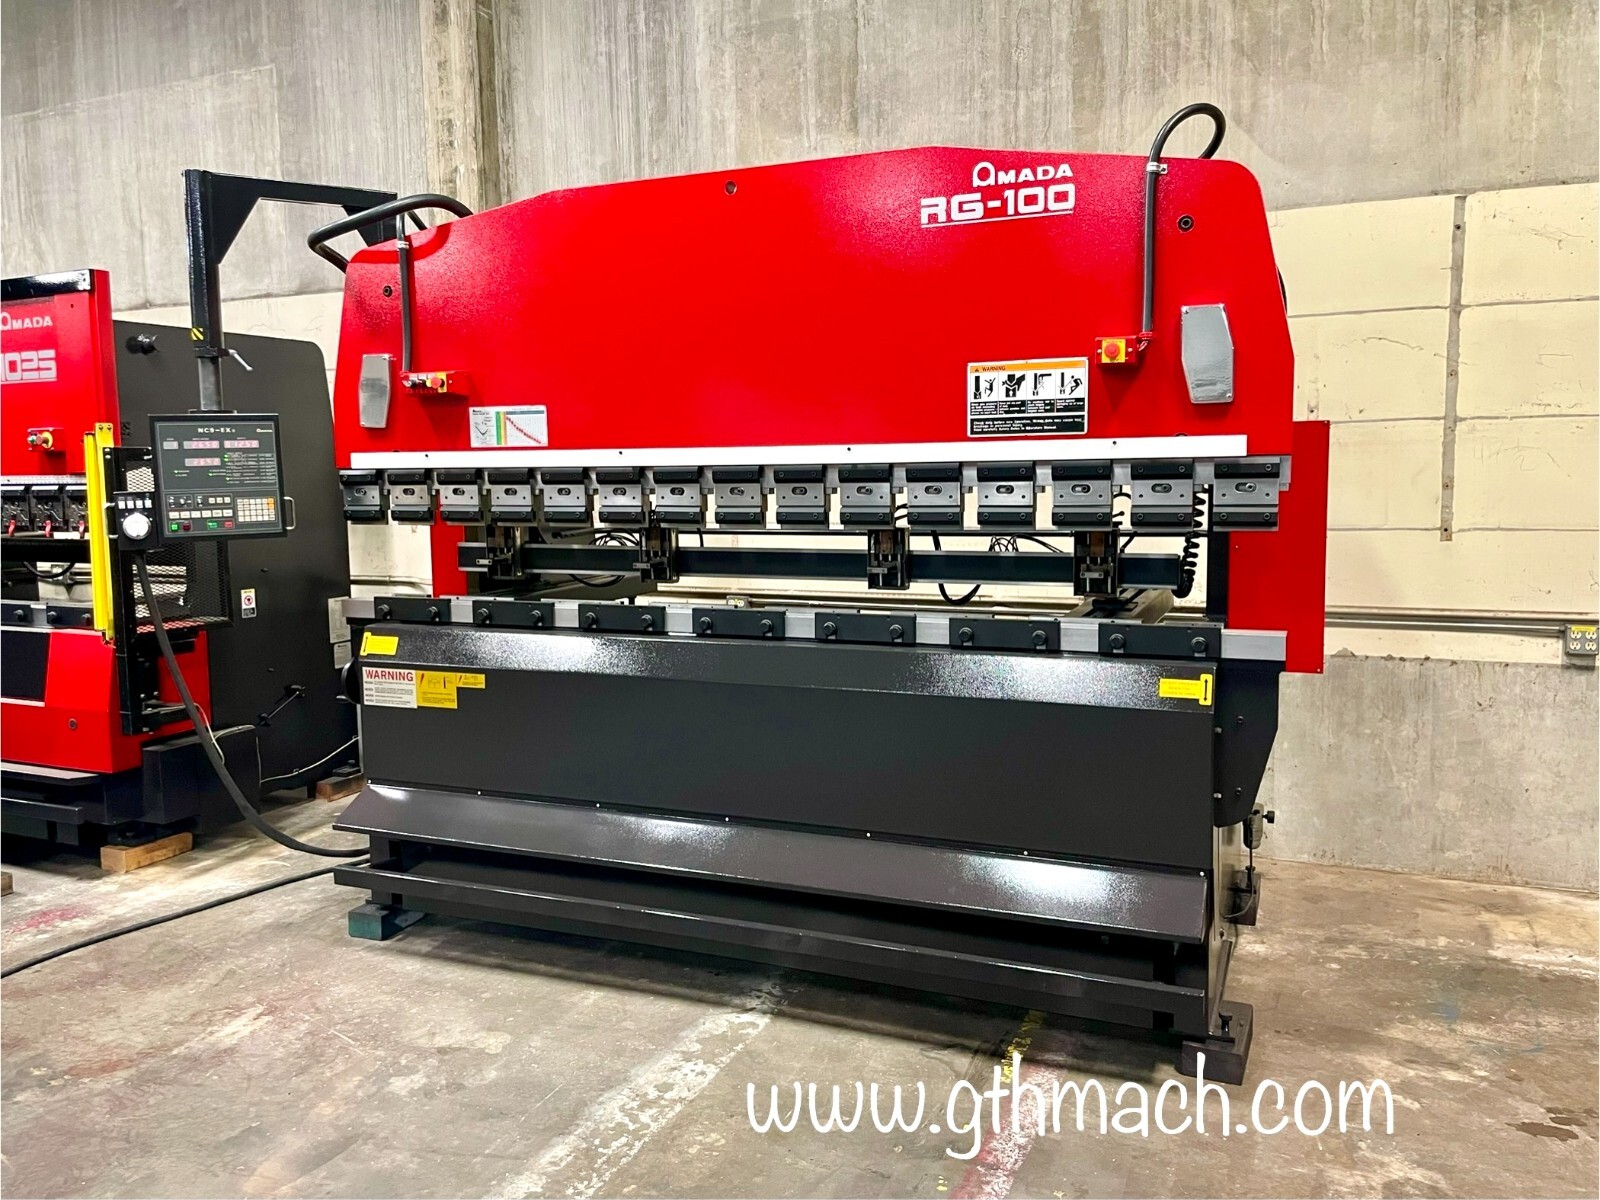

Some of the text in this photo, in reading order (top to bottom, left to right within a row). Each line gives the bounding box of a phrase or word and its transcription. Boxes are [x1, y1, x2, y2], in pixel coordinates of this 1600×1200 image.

[973, 161, 1074, 188] AMADA
[920, 183, 1076, 225] RG-100
[1, 311, 53, 331] AMADA
[365, 669, 414, 682] WARNING
